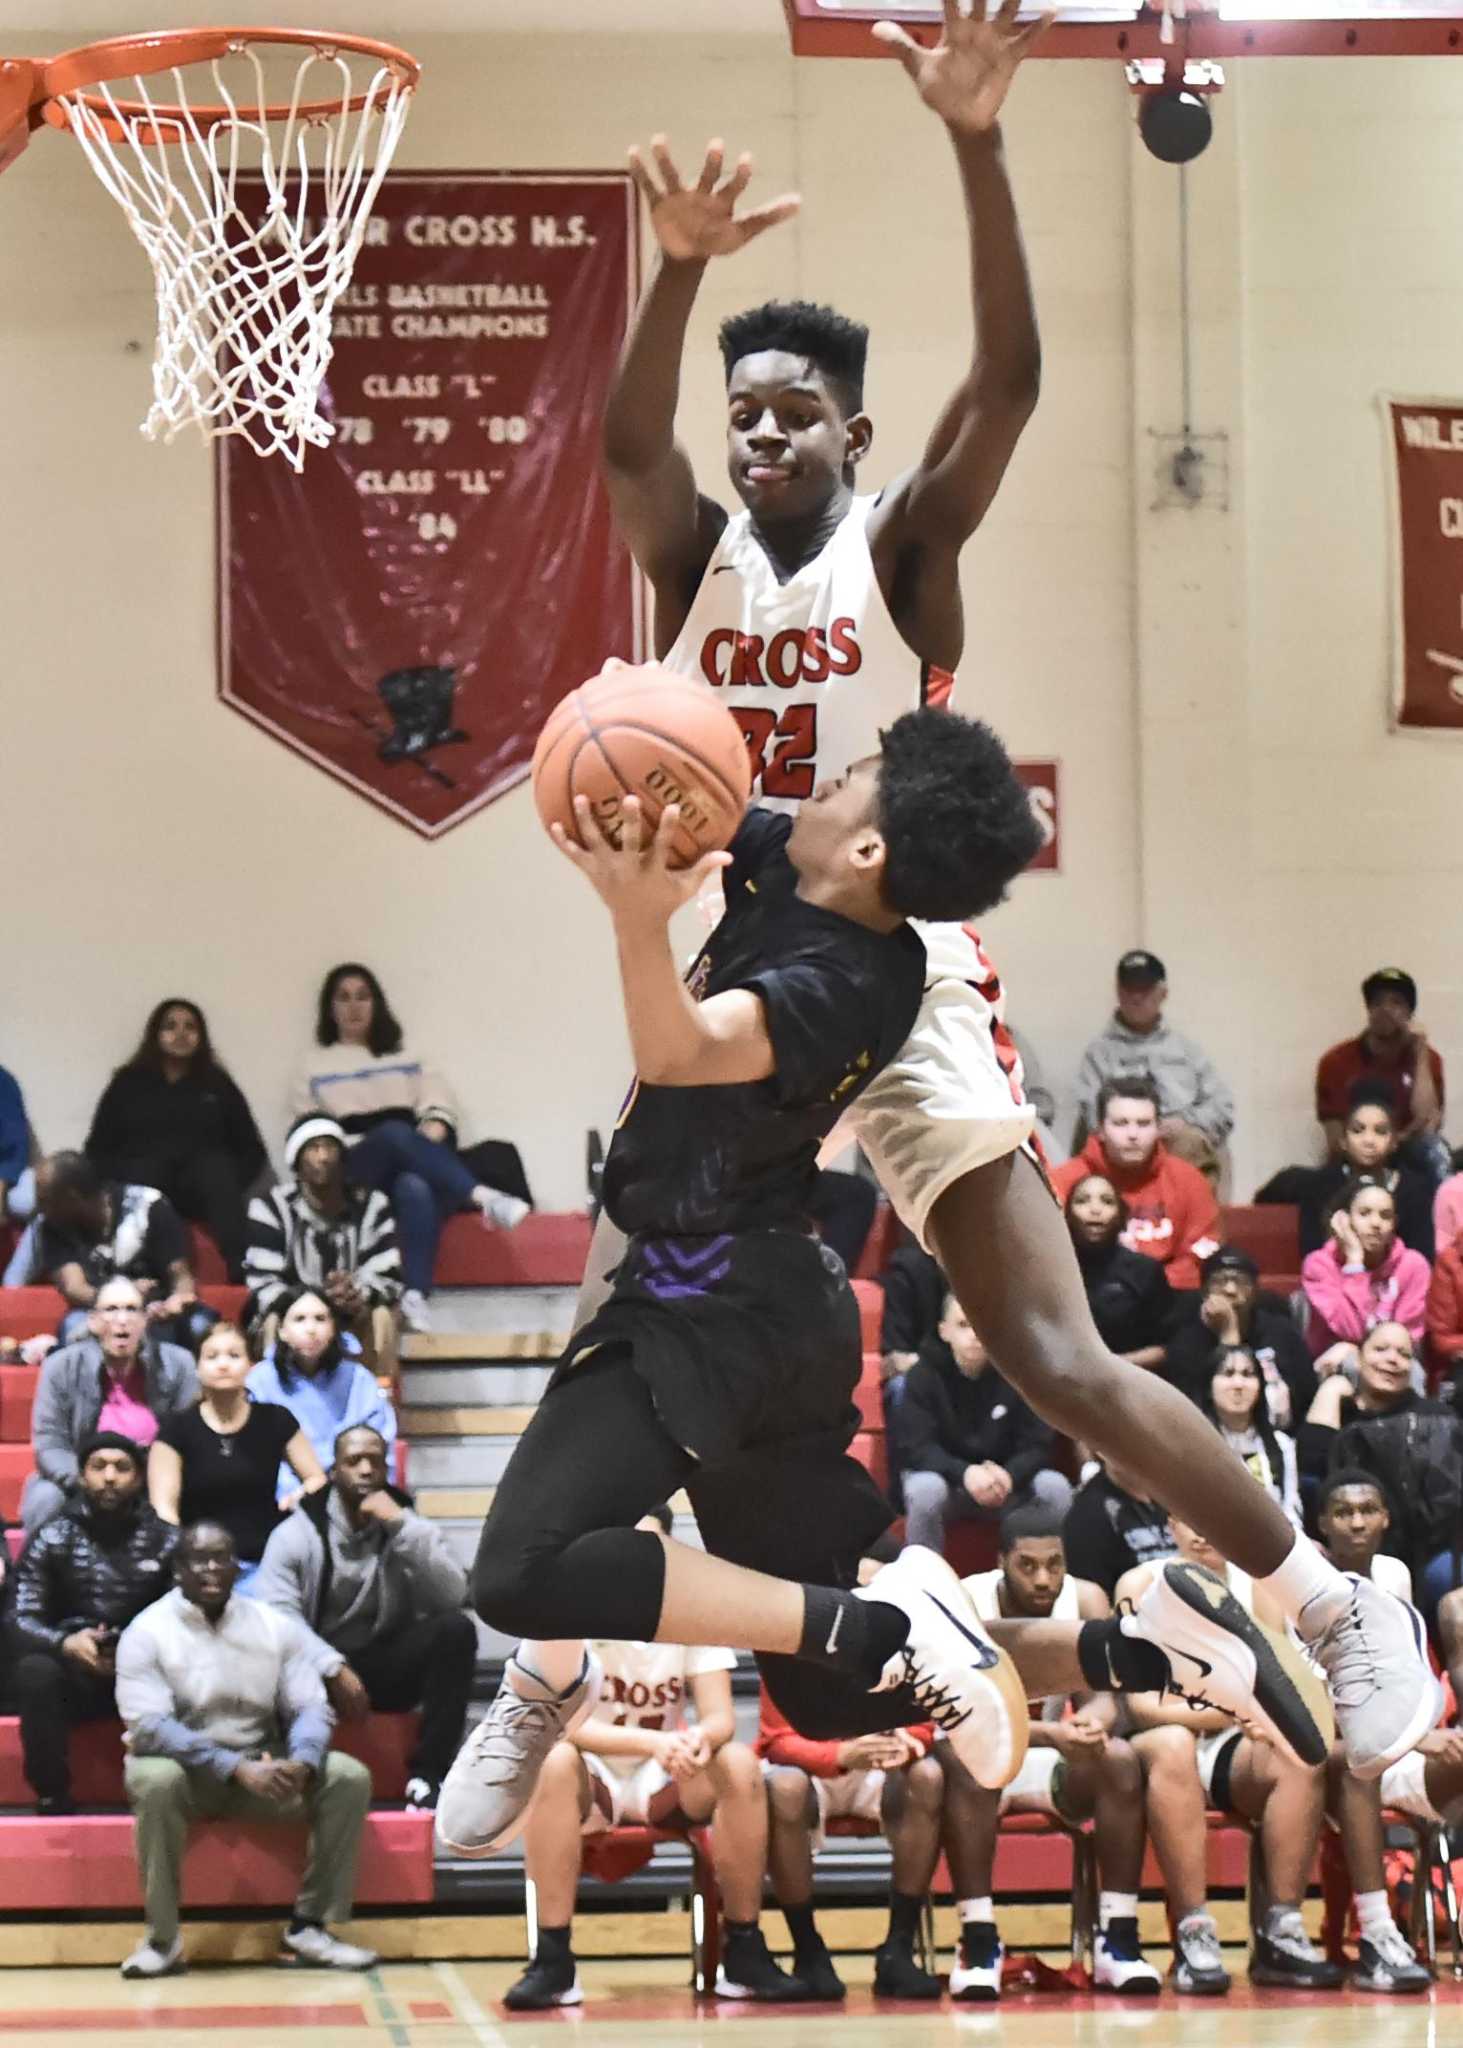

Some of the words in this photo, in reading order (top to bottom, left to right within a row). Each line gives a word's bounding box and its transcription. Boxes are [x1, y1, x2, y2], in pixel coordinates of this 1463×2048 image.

[404, 214, 517, 247] CROSS
[530, 214, 598, 247] H.S.
[387, 284, 549, 308] BASKETBALL
[391, 314, 548, 338] CHAMPIONS
[362, 373, 441, 399] CLASS
[355, 469, 435, 495] CLASS
[700, 616, 862, 689] CROSS
